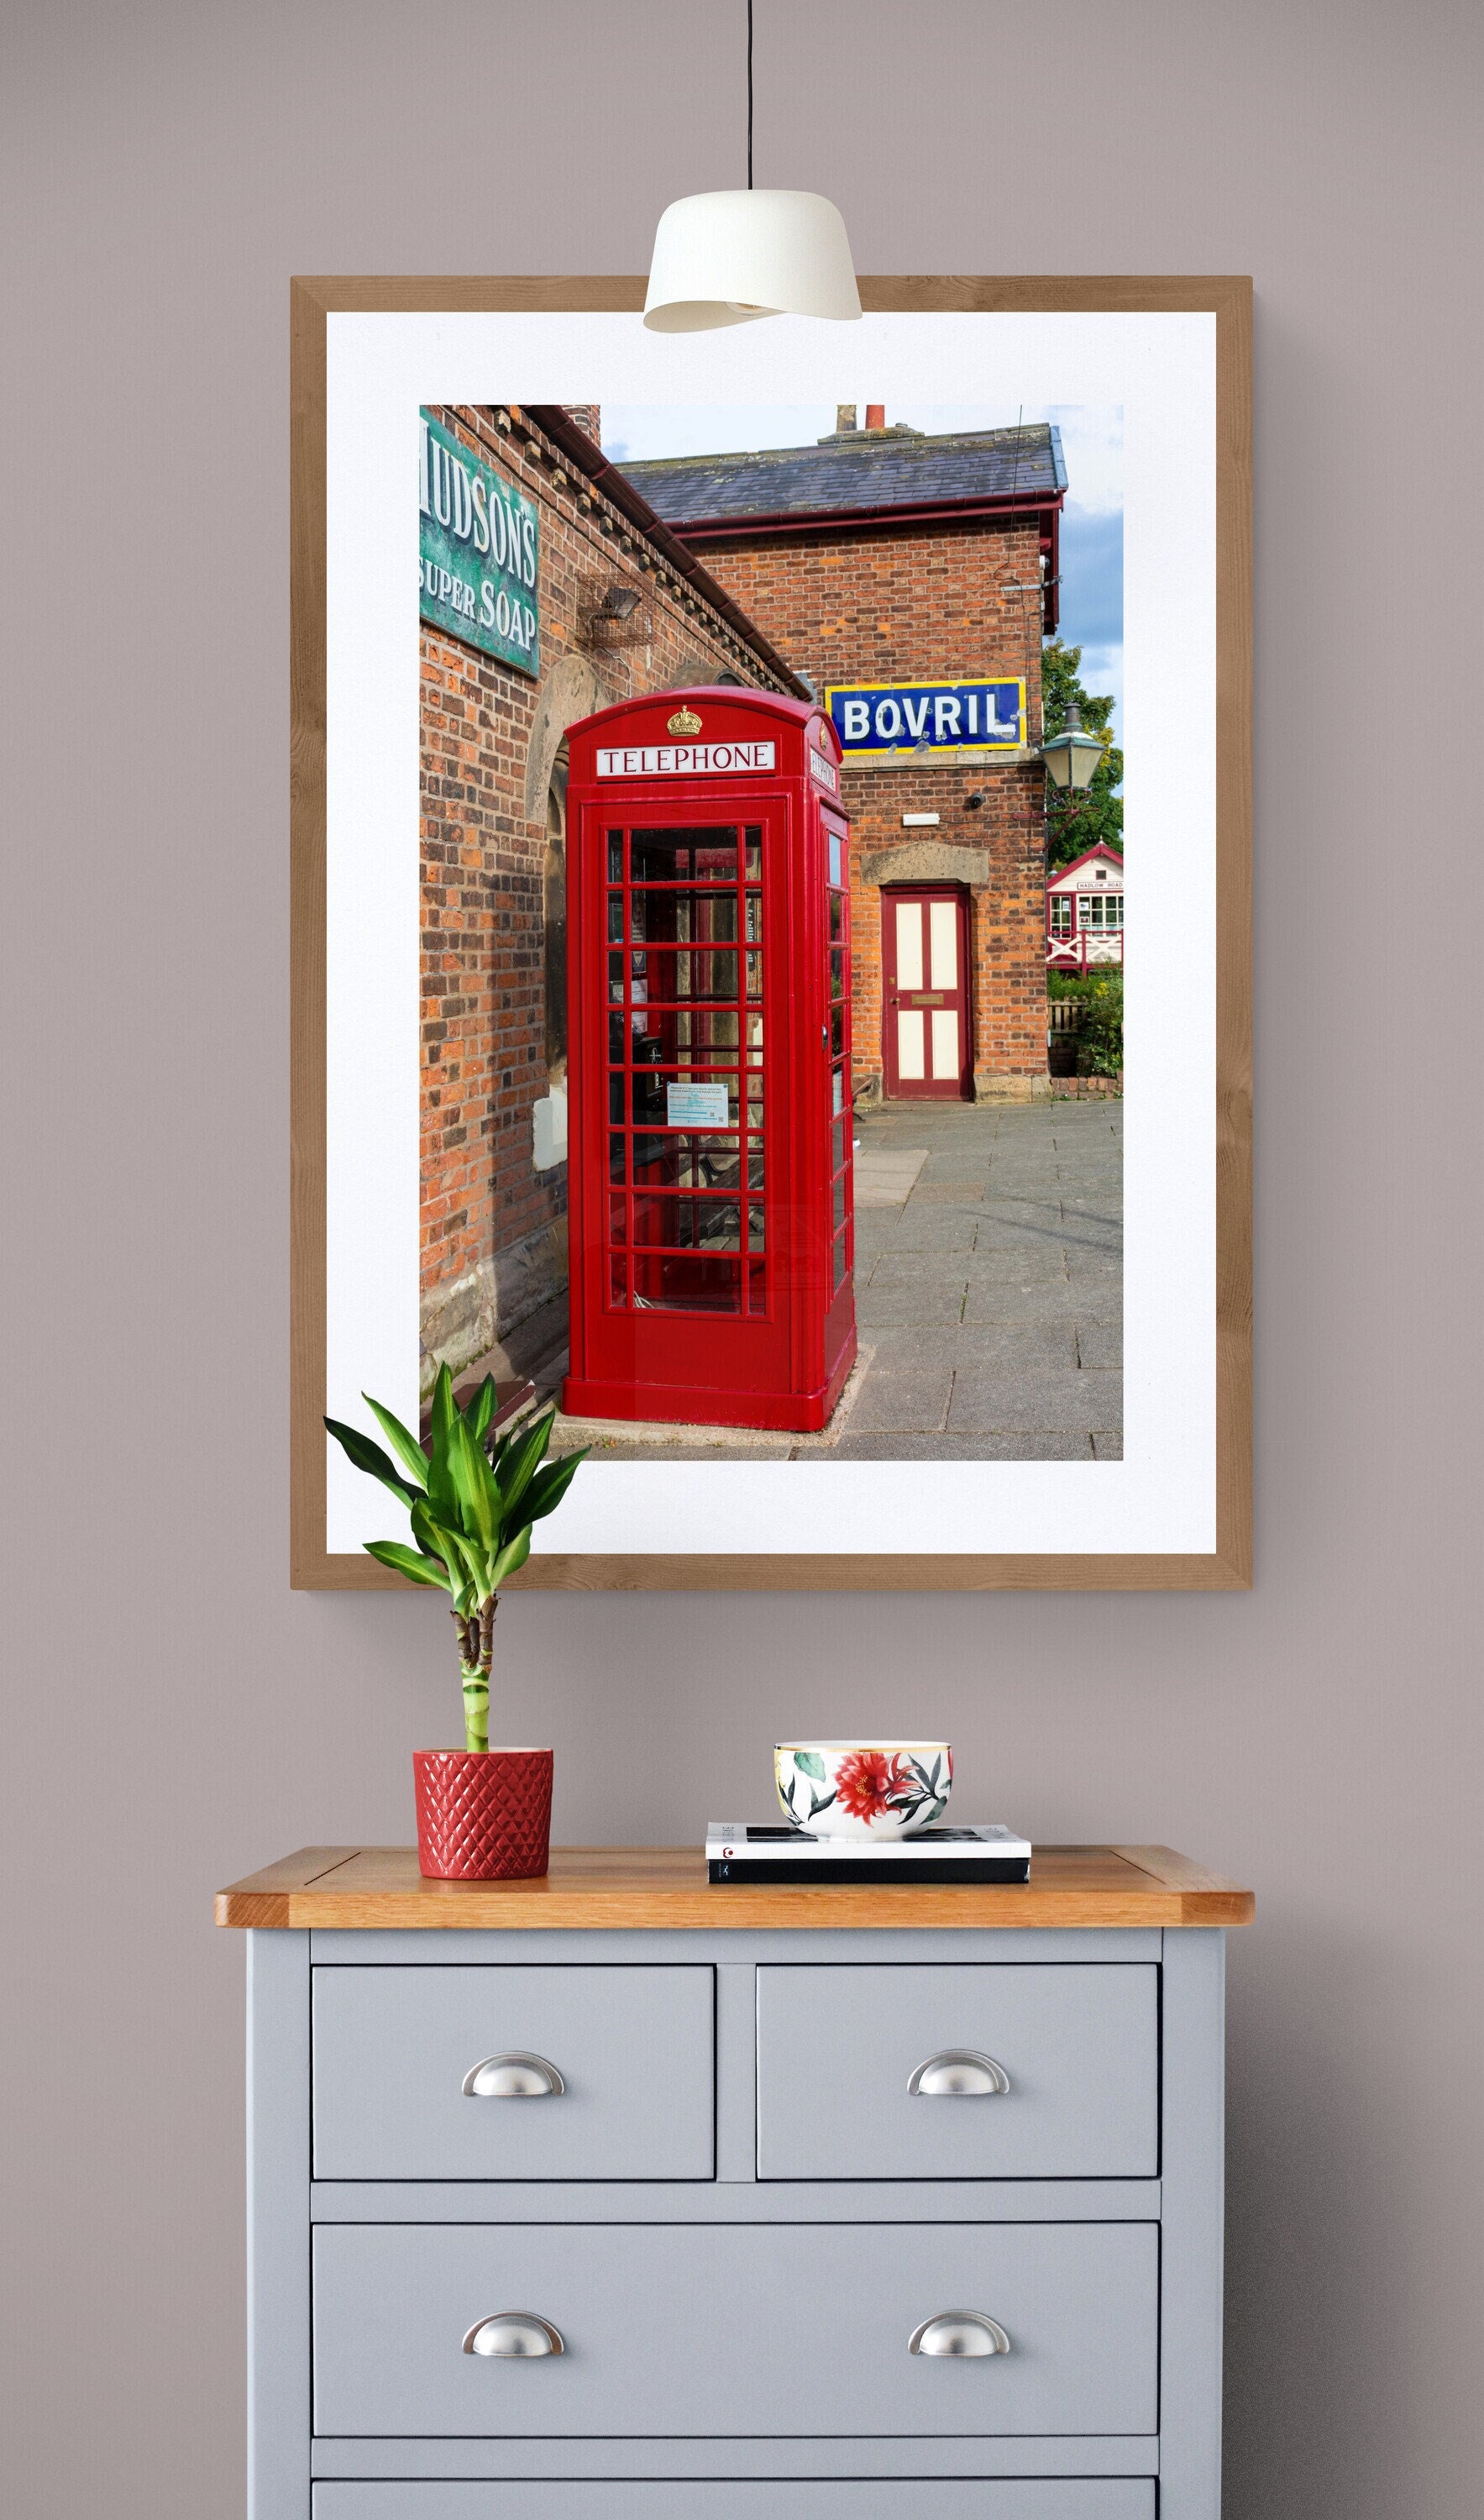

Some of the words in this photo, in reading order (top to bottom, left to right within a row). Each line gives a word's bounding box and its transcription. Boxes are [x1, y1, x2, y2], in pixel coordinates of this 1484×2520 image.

[480, 580, 536, 651] SOAP
[844, 693, 1015, 740] BOVRIL
[604, 744, 768, 774] TELEPHONE
